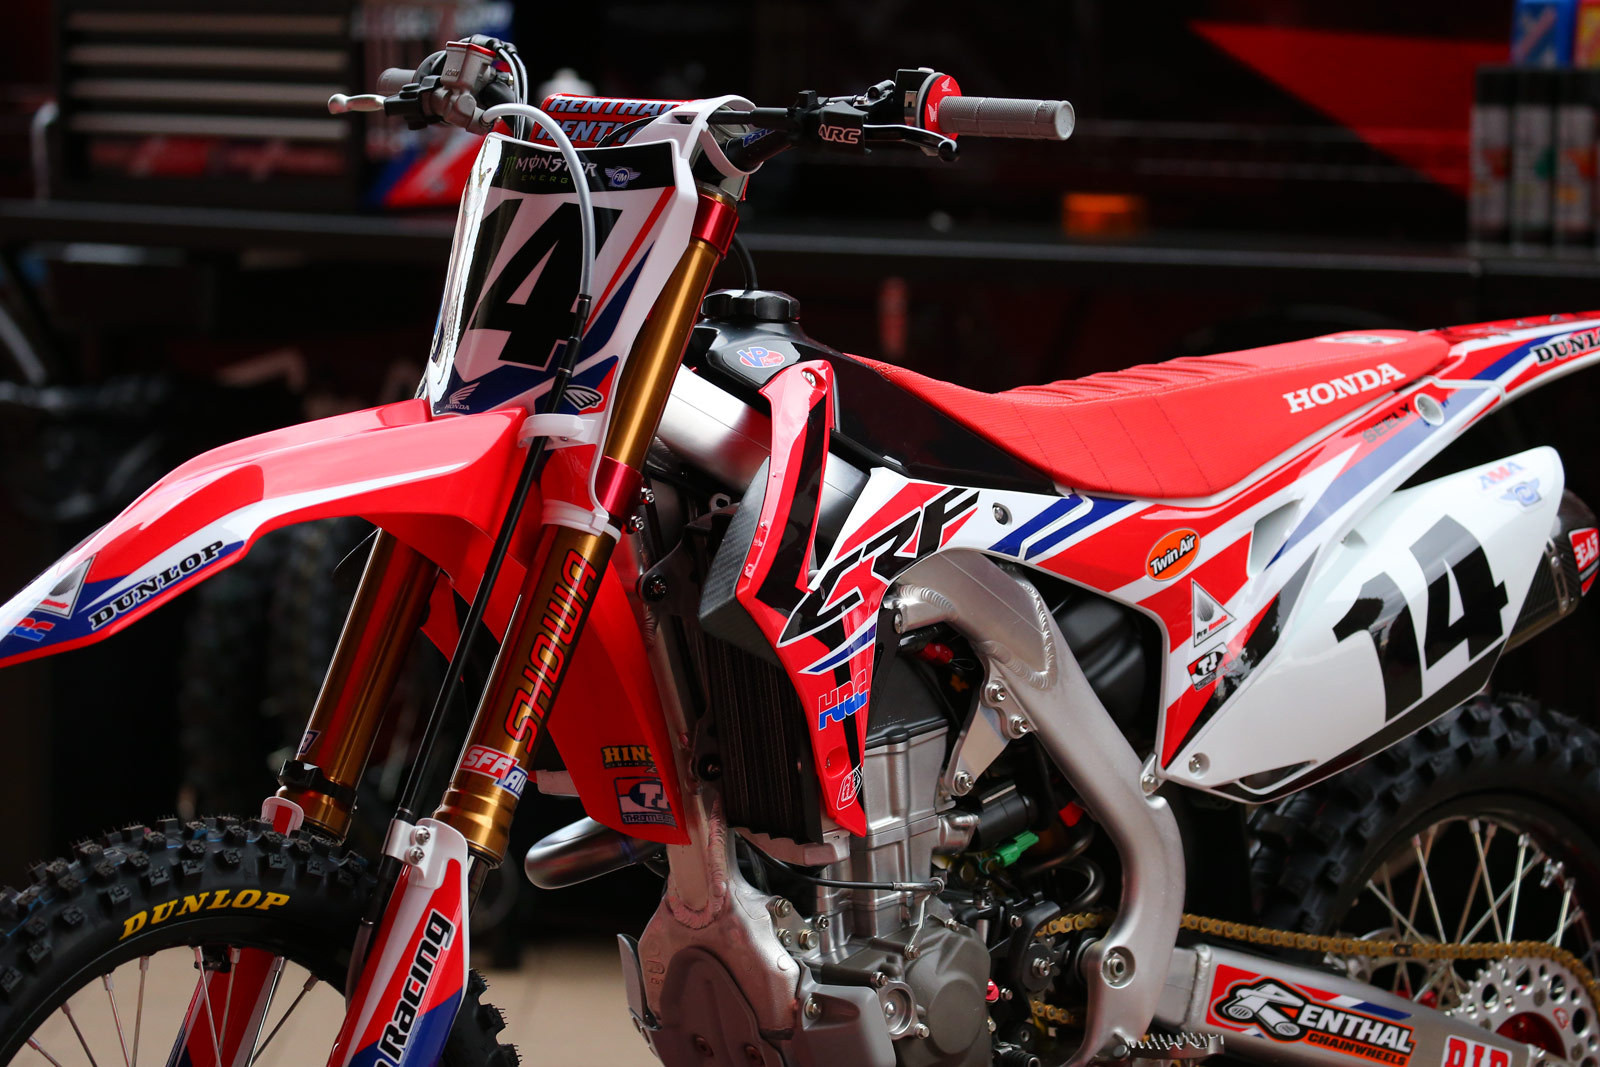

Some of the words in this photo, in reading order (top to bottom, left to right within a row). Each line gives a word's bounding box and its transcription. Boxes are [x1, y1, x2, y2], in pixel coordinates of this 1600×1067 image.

[818, 124, 862, 144] ARC
[521, 173, 570, 185] ENERG
[737, 346, 769, 367] VP
[1534, 331, 1600, 363] DUNL
[444, 403, 470, 411] HONDA
[1283, 363, 1406, 414] HONDA
[1362, 402, 1413, 443] SEELY
[1478, 461, 1524, 490] AMA
[776, 486, 981, 648] CRF
[1150, 548, 1179, 576] Twin
[1179, 534, 1196, 557] Air
[89, 540, 224, 630] DUNLOP
[1332, 513, 1509, 724] 14
[505, 548, 598, 753] SHOWA
[818, 668, 869, 731] HRC
[462, 748, 513, 774] SFF
[118, 889, 290, 941] DUNLOP
[378, 908, 456, 1064] Racing
[1307, 1032, 1407, 1067] CHAINWHEELS
